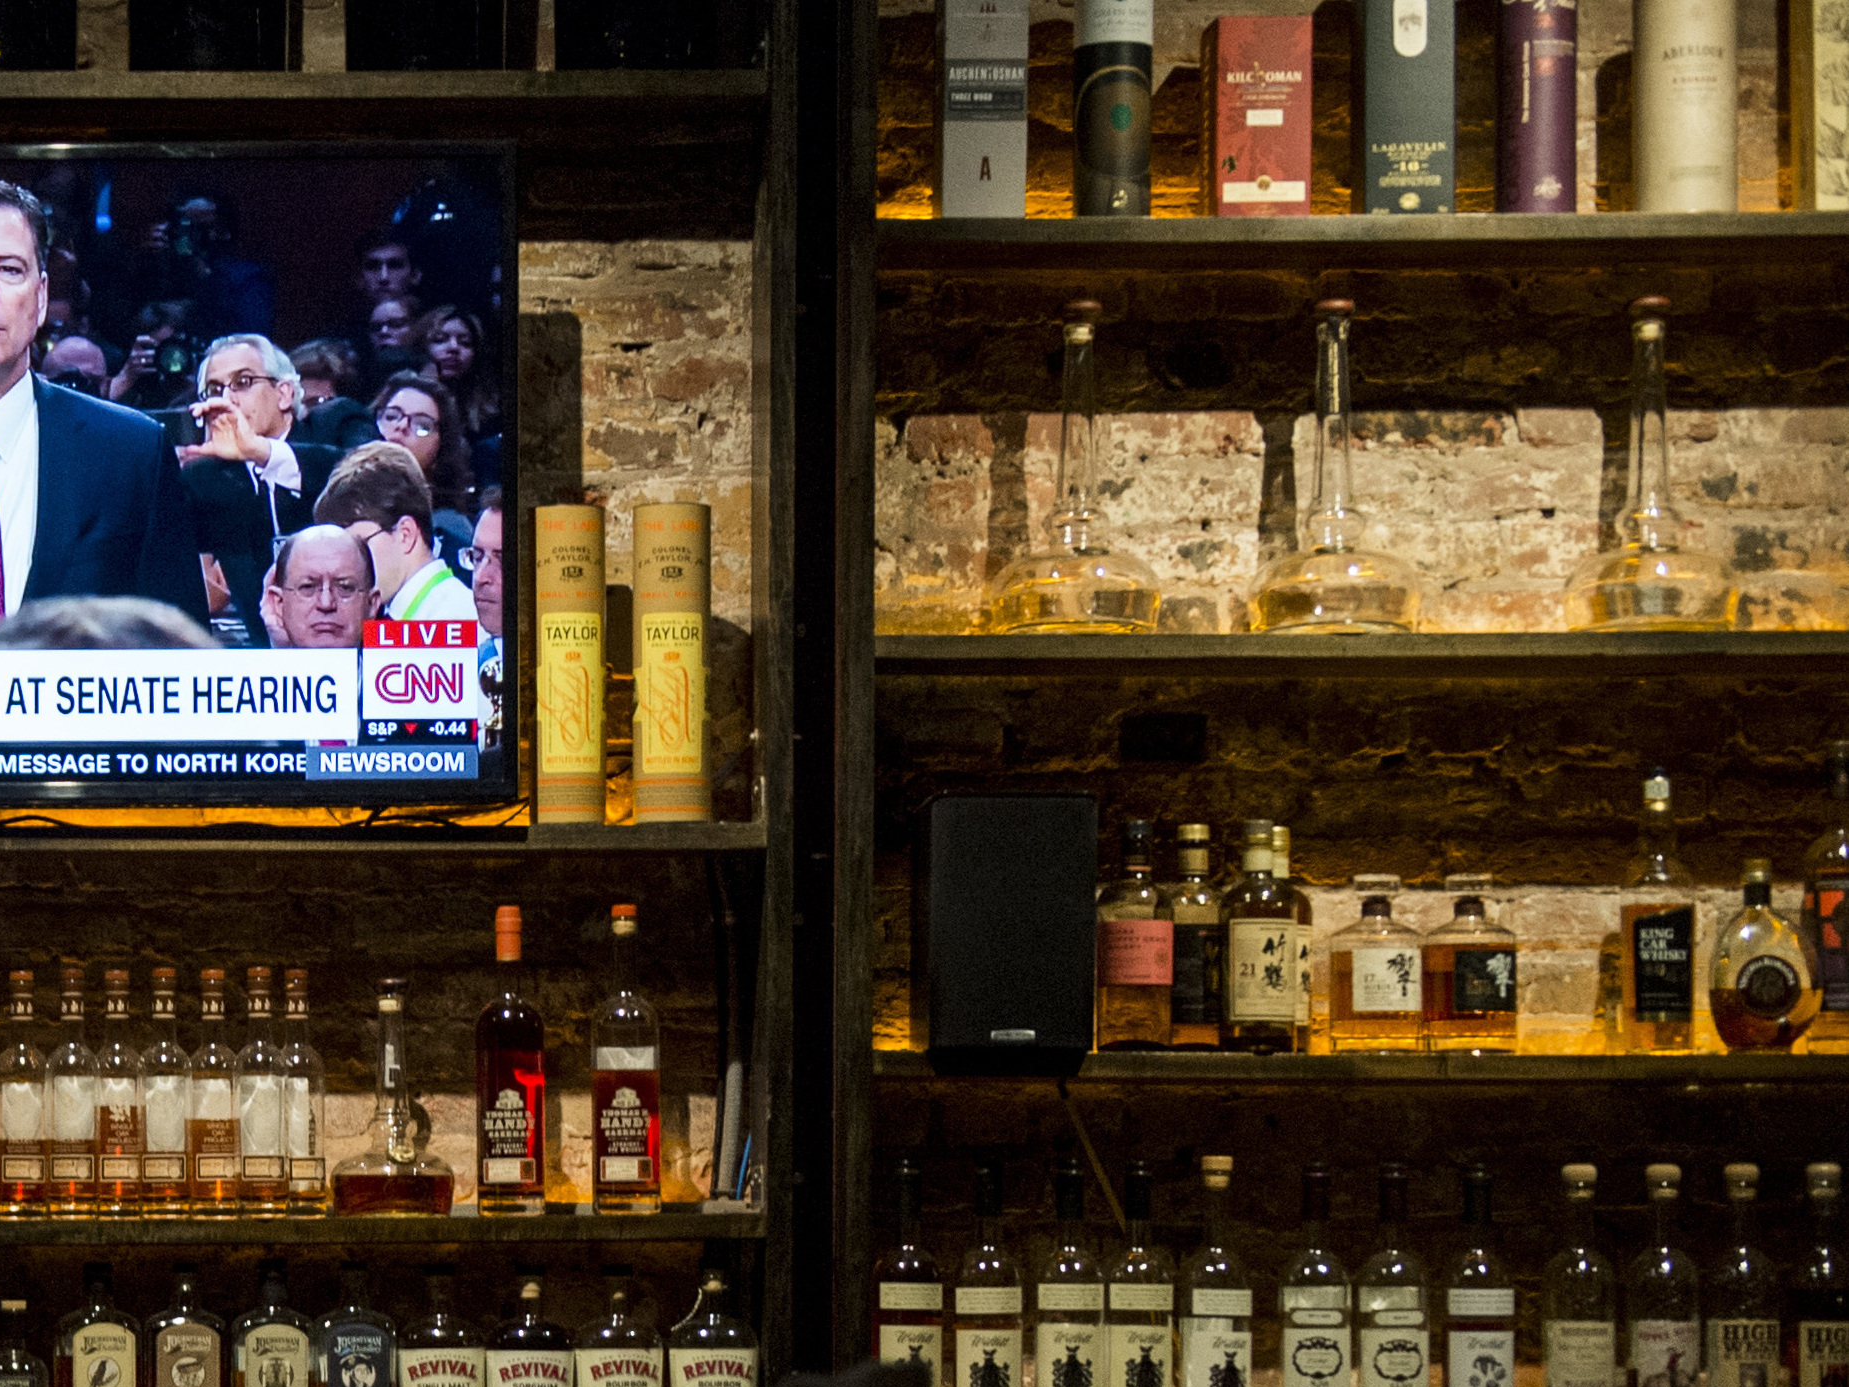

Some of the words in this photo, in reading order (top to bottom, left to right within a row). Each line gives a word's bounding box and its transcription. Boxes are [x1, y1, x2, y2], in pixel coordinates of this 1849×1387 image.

[980, 156, 991, 181] A
[555, 554, 591, 563] TAYLOR
[654, 554, 691, 563] TAYLOR
[378, 623, 464, 646] LIVE
[545, 626, 599, 641] TAYLOR
[646, 626, 700, 641] TAYLOR
[375, 662, 464, 703] CNN
[5, 677, 46, 715] AT
[56, 676, 180, 715] SENATE
[193, 674, 337, 715] HEARING
[367, 721, 398, 737] S&P
[428, 721, 467, 737] -0.44
[117, 754, 149, 774] TO
[156, 754, 233, 774] NORTH
[242, 754, 307, 774] KORE
[319, 752, 465, 774] NEWSROOM
[1639, 928, 1675, 940] KING
[485, 1110, 524, 1118] THOMAS
[602, 1109, 640, 1117] THOMAS
[483, 1118, 535, 1130] HANDY
[600, 1117, 652, 1128] HANDY
[1806, 1328, 1848, 1343] HIG
[407, 1359, 477, 1382] REVIVAL
[499, 1362, 568, 1384] REVIVAL
[589, 1359, 660, 1382] REVIVAL
[683, 1359, 753, 1381] REVIVAL
